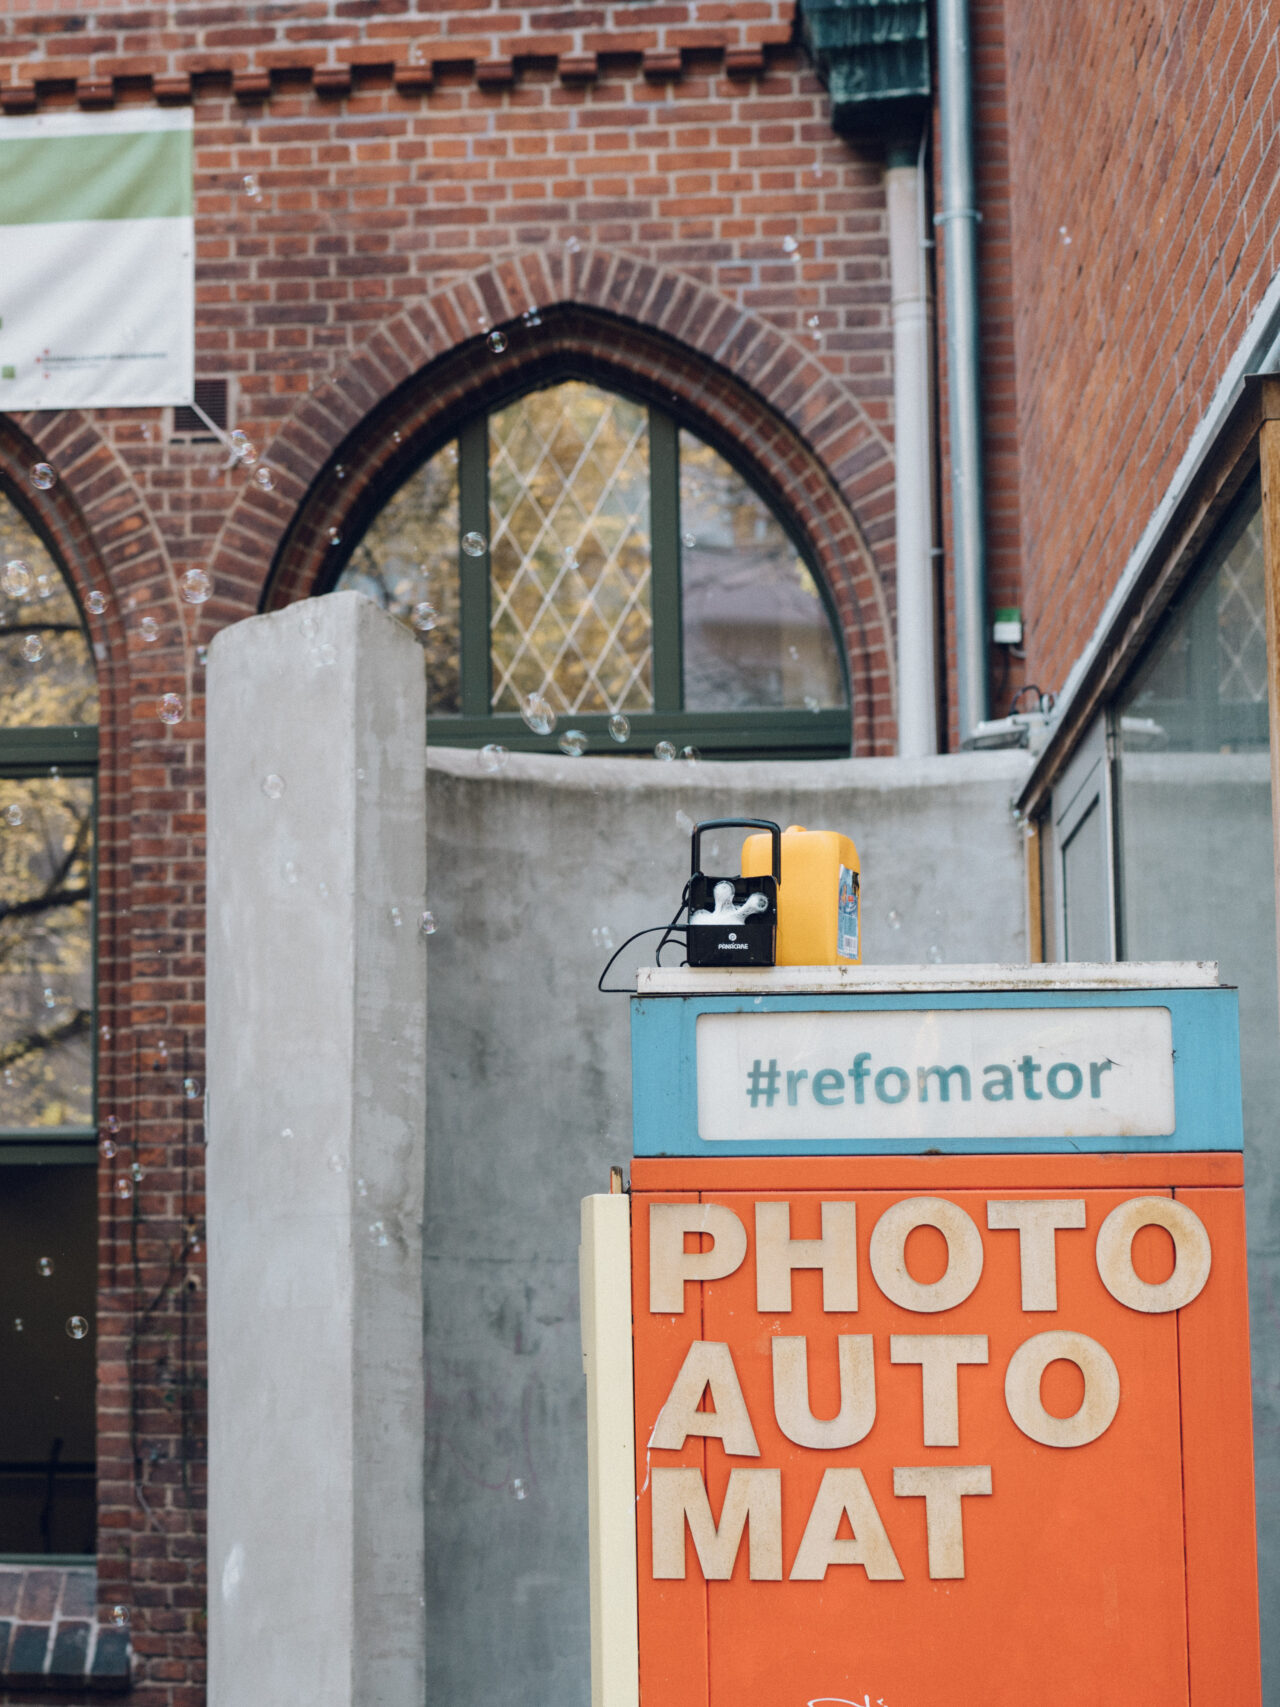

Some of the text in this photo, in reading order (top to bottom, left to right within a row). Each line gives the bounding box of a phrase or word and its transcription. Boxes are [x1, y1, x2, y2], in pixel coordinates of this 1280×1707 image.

[745, 1052, 1114, 1108] #refomator
[649, 1196, 1212, 1313] PHOTO
[647, 1330, 1121, 1457] AUTO
[650, 1465, 993, 1581] MAT
